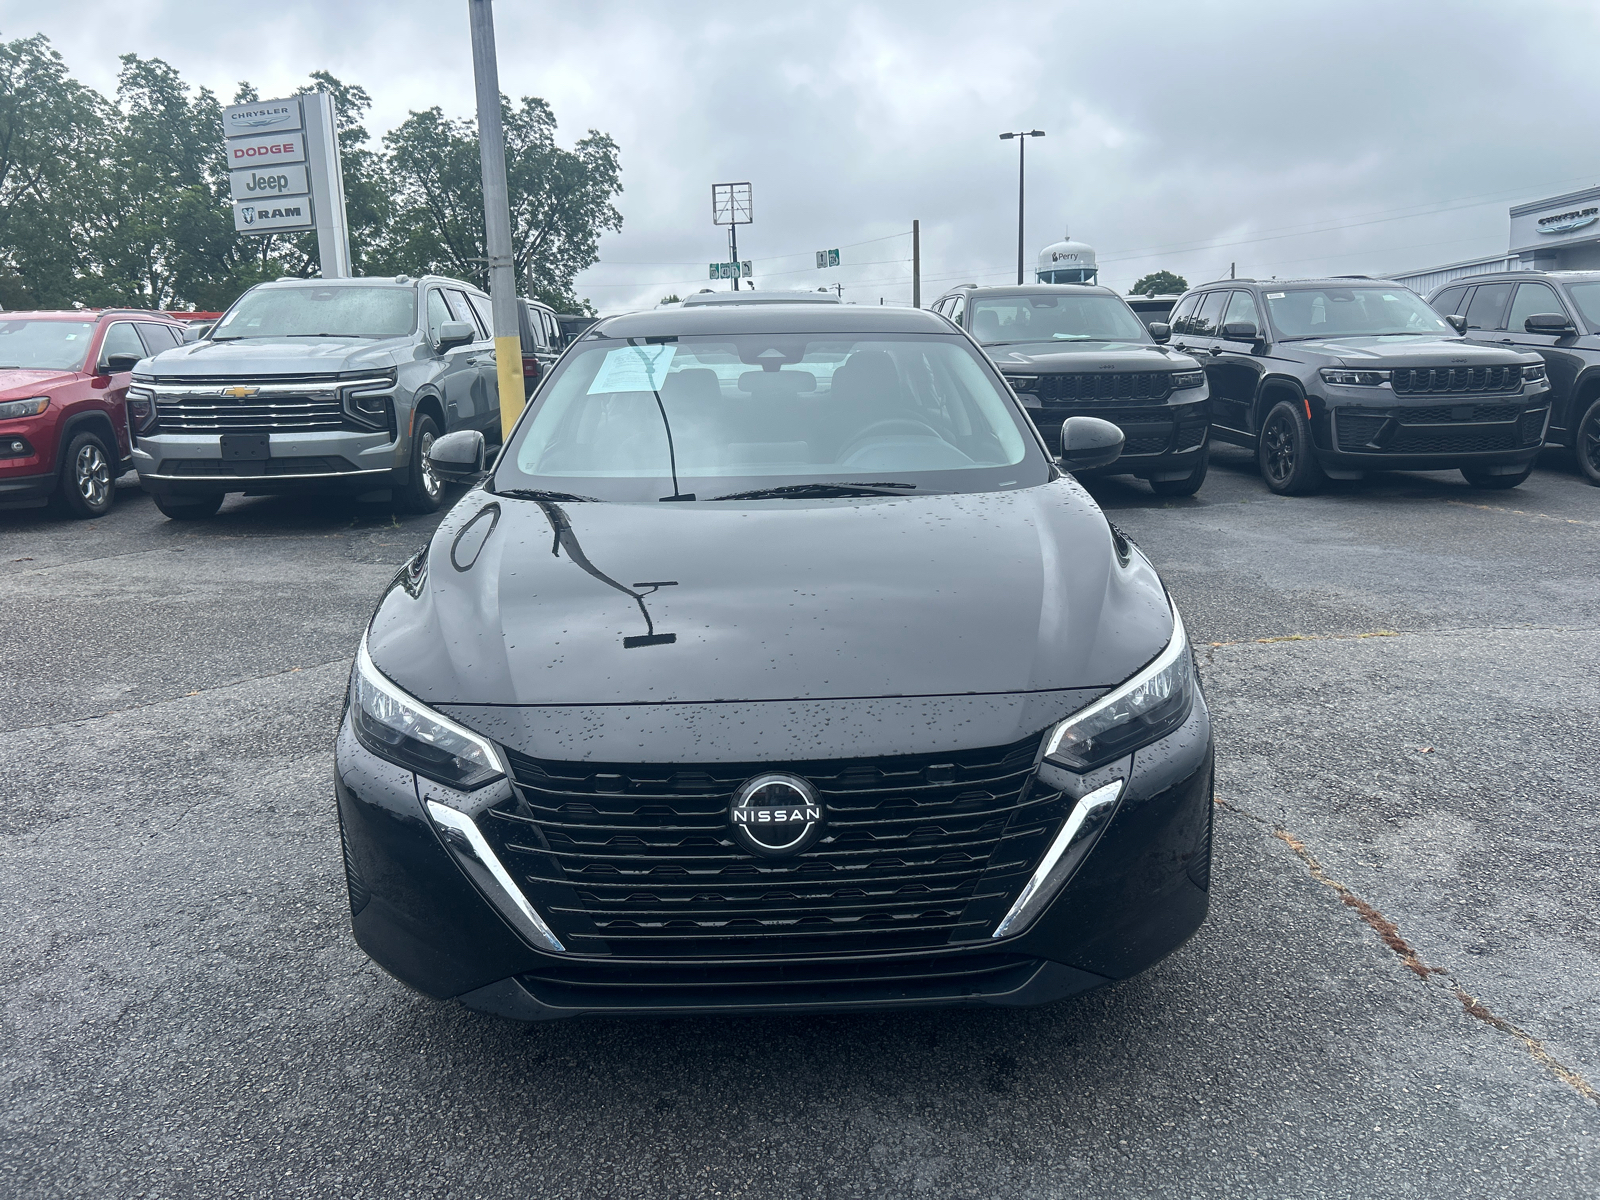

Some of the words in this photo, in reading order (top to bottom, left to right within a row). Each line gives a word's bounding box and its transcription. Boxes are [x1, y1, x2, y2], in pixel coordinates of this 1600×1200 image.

[231, 107, 289, 120] CHRYSLER
[233, 143, 295, 159] DODGE
[245, 172, 289, 193] Jeep
[257, 207, 302, 220] RAM
[1058, 252, 1079, 262] Perry
[733, 807, 820, 822] NISSAN
